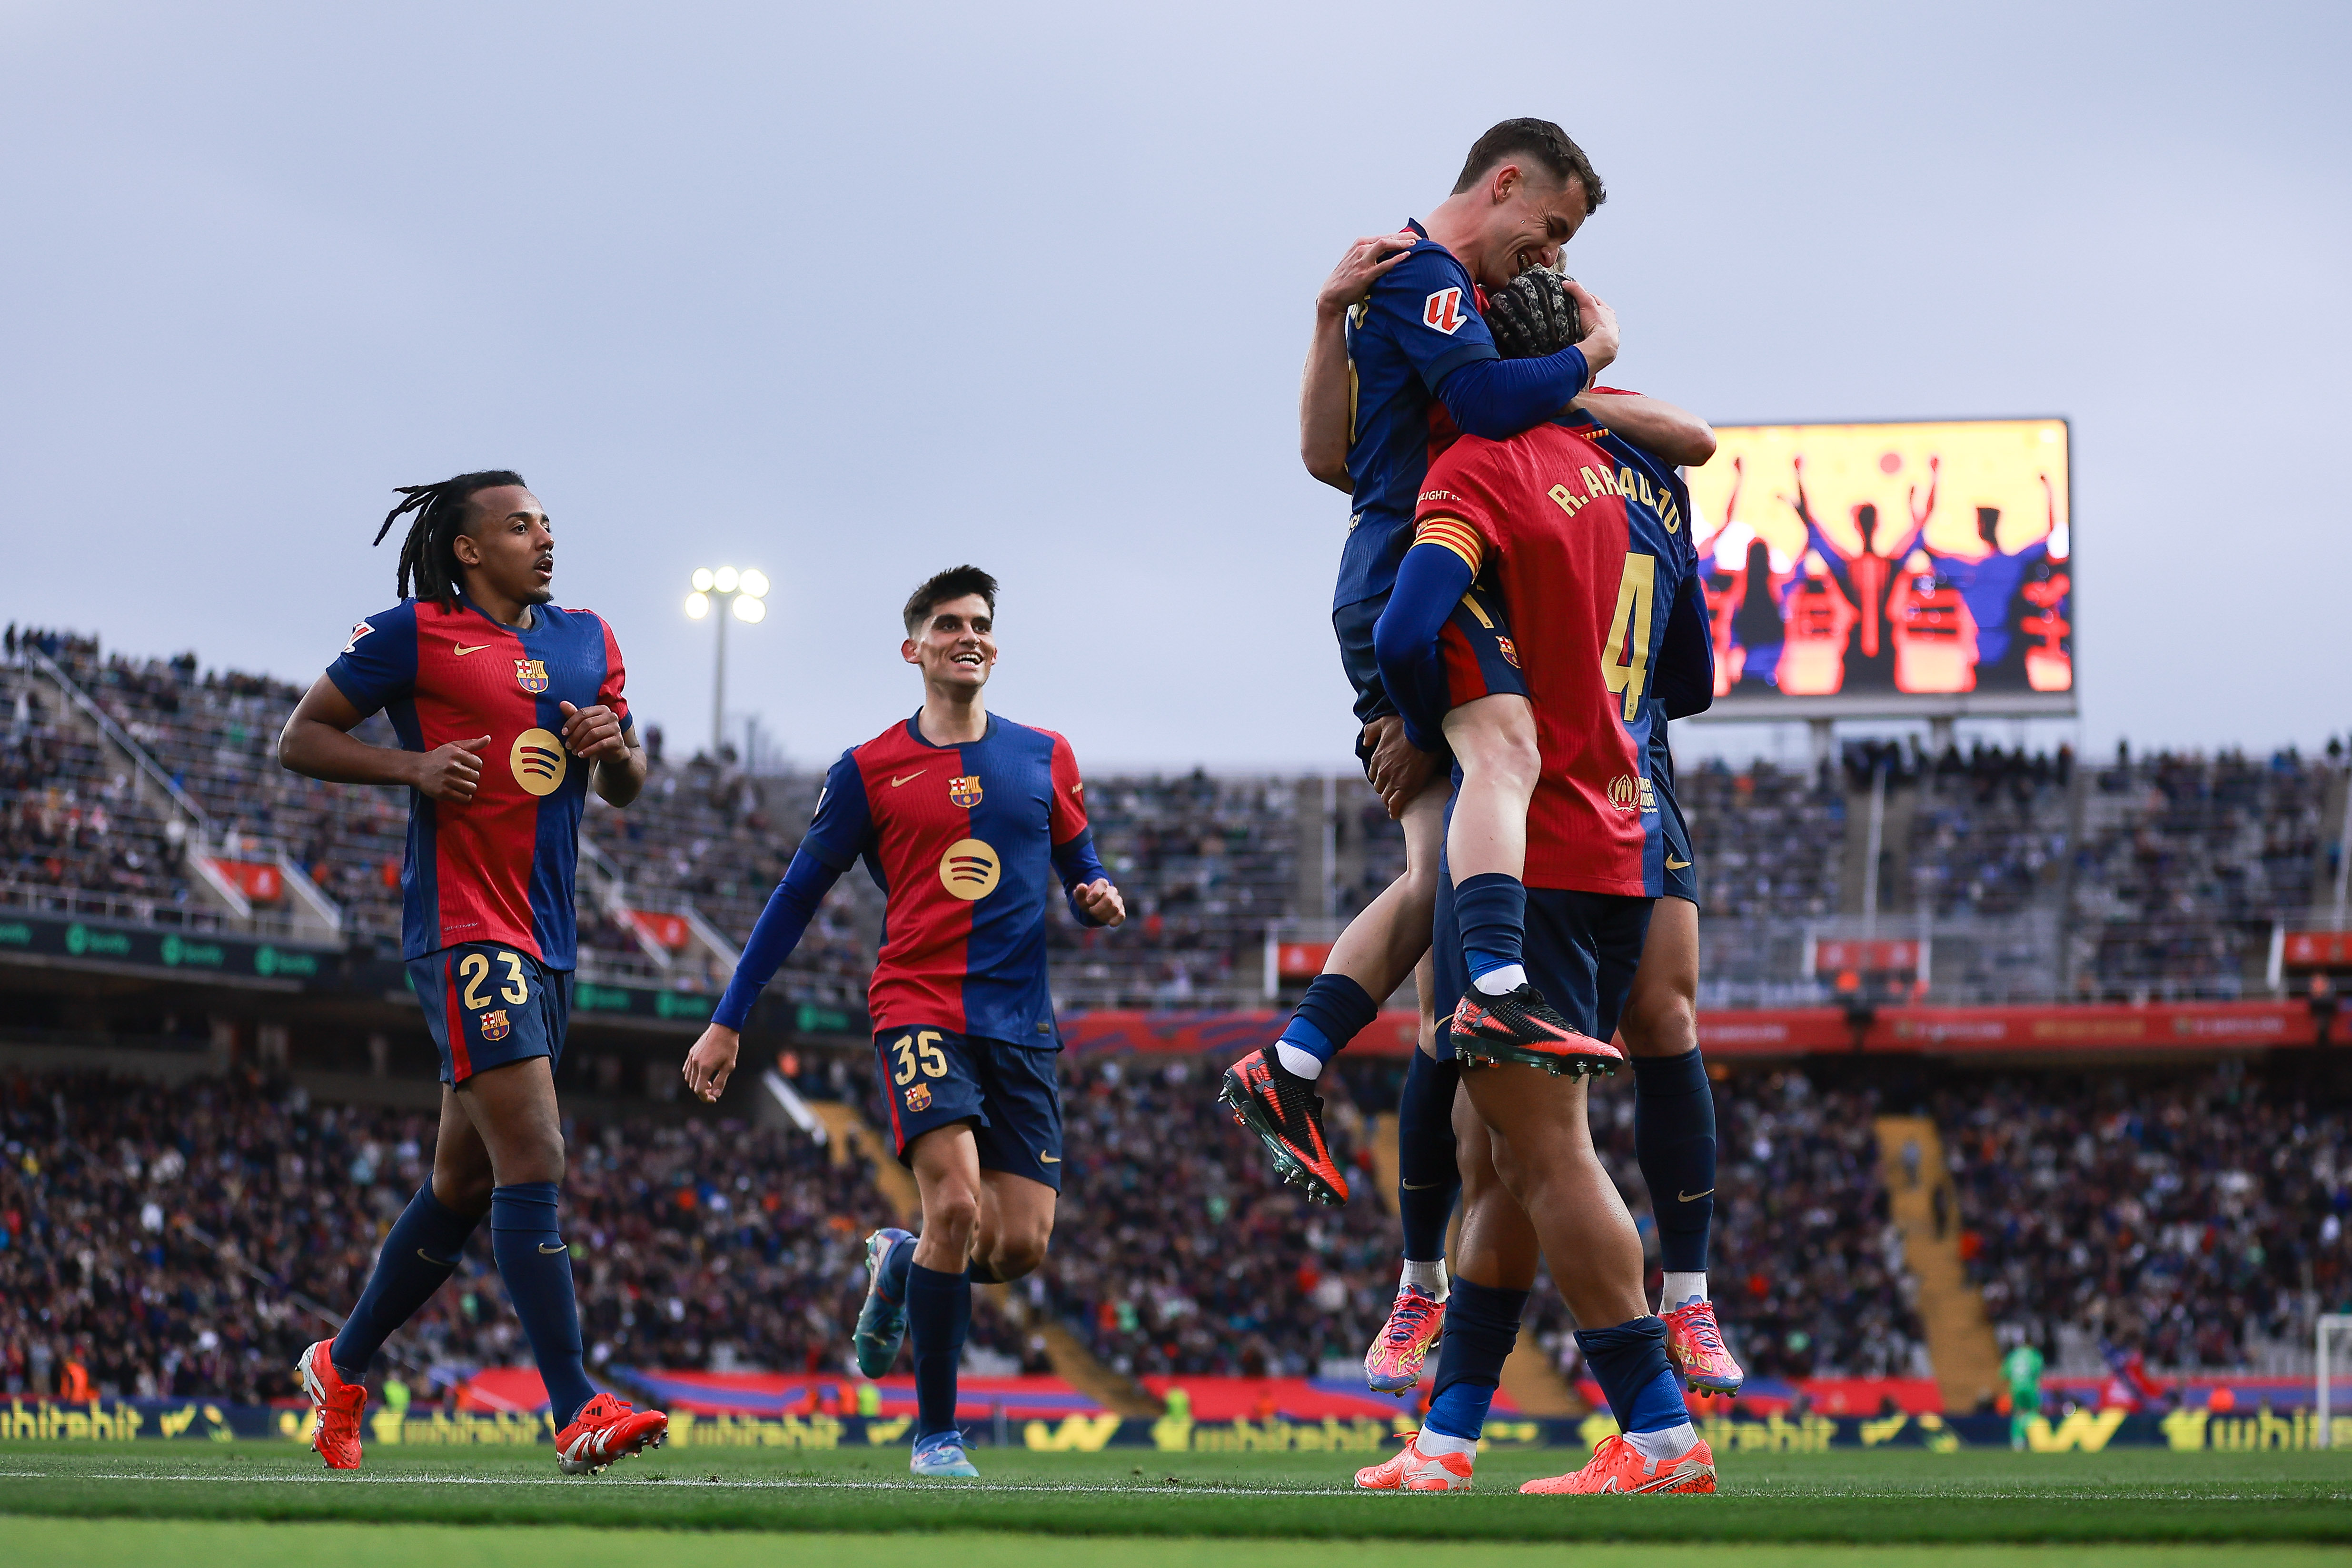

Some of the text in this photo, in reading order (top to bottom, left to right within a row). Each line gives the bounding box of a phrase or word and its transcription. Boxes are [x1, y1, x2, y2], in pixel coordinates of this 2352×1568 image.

[1601, 551, 1655, 722] 4
[460, 951, 528, 1010] 23
[892, 1031, 948, 1086] 35
